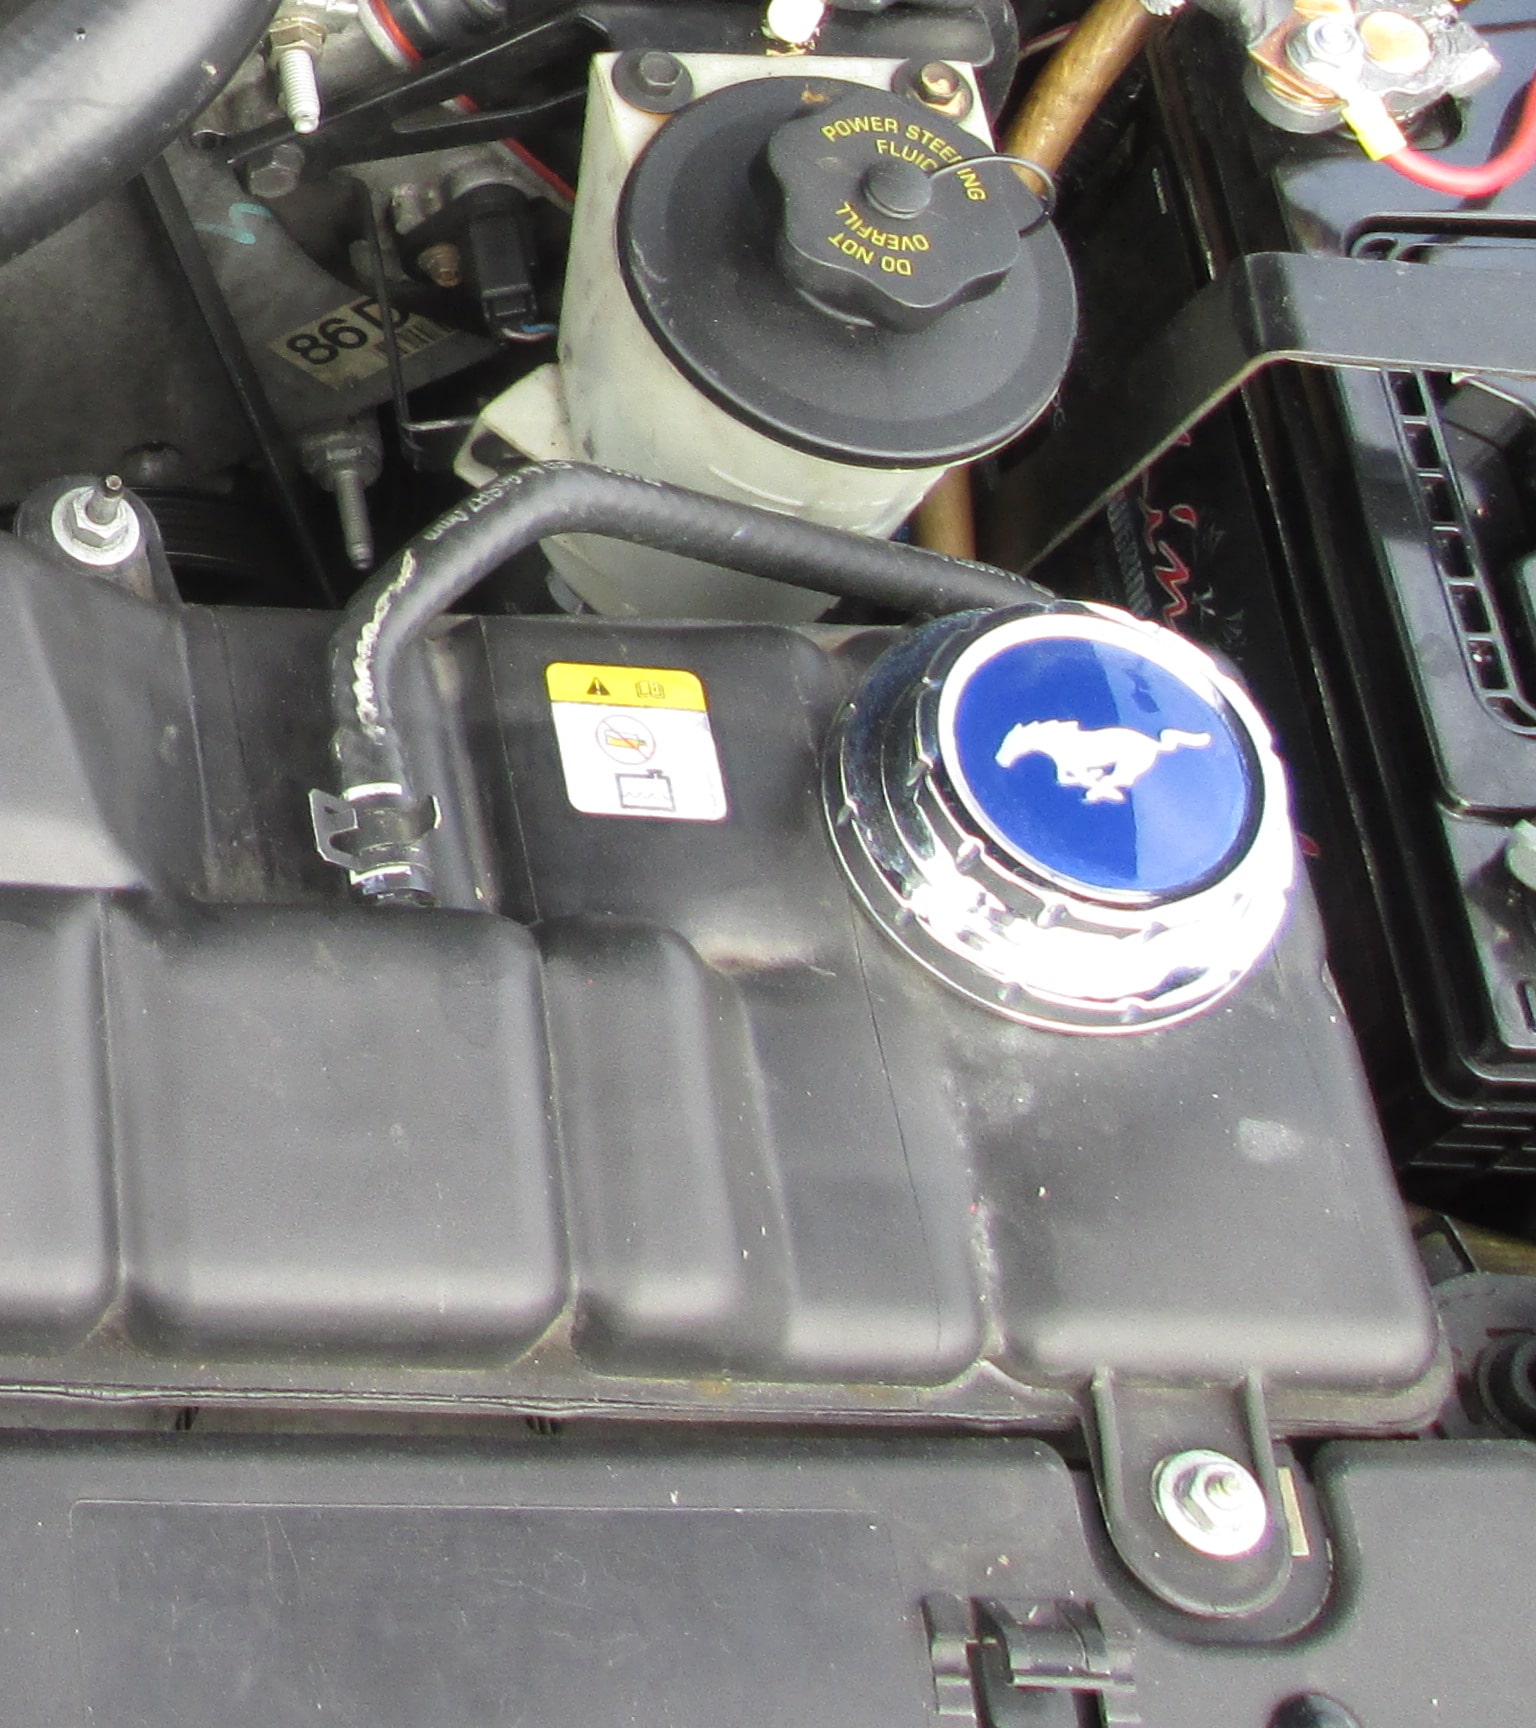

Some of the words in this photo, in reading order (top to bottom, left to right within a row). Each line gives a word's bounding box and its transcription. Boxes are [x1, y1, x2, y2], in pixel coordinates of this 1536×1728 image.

[820, 116, 899, 143] POWER
[834, 201, 931, 252] OVERFILL
[827, 232, 875, 266] NOT
[880, 255, 913, 277] DO
